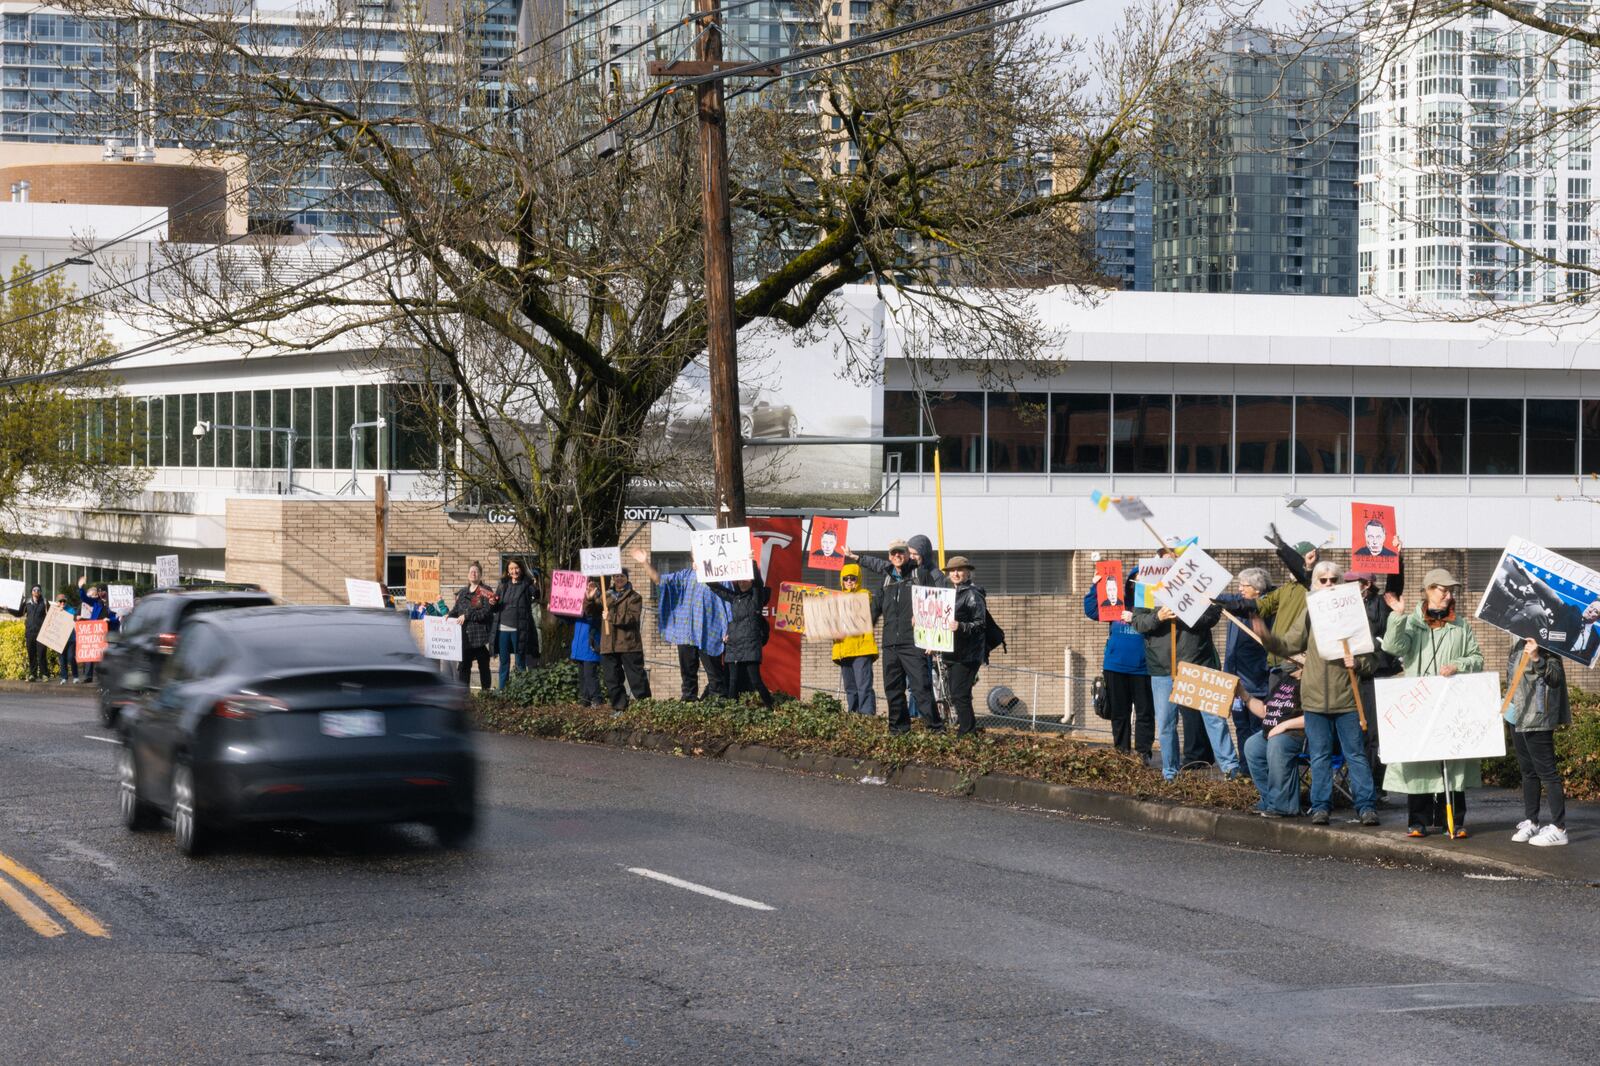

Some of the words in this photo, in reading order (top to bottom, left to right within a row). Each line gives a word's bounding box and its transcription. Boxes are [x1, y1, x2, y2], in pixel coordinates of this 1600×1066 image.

[1363, 509, 1369, 519] I
[1371, 510, 1385, 520] AM
[590, 551, 613, 561] Save
[718, 545, 728, 557] A
[1517, 540, 1580, 579] BOYCOTT
[1140, 565, 1172, 577] HAND
[1164, 558, 1199, 597] MUSK
[554, 573, 574, 588] STAND
[576, 576, 586, 589] UP
[1177, 593, 1195, 612] OR
[1193, 573, 1213, 594] US
[551, 595, 583, 611] DEMOCRACY
[78, 624, 92, 634] SAVE
[1181, 667, 1200, 679] NO
[1202, 672, 1233, 690] KING
[1176, 681, 1196, 694] NO
[1199, 687, 1228, 703] DOGE
[1173, 693, 1193, 706] NO
[1199, 698, 1219, 714] ICE
[1384, 679, 1431, 729] FIGHT
